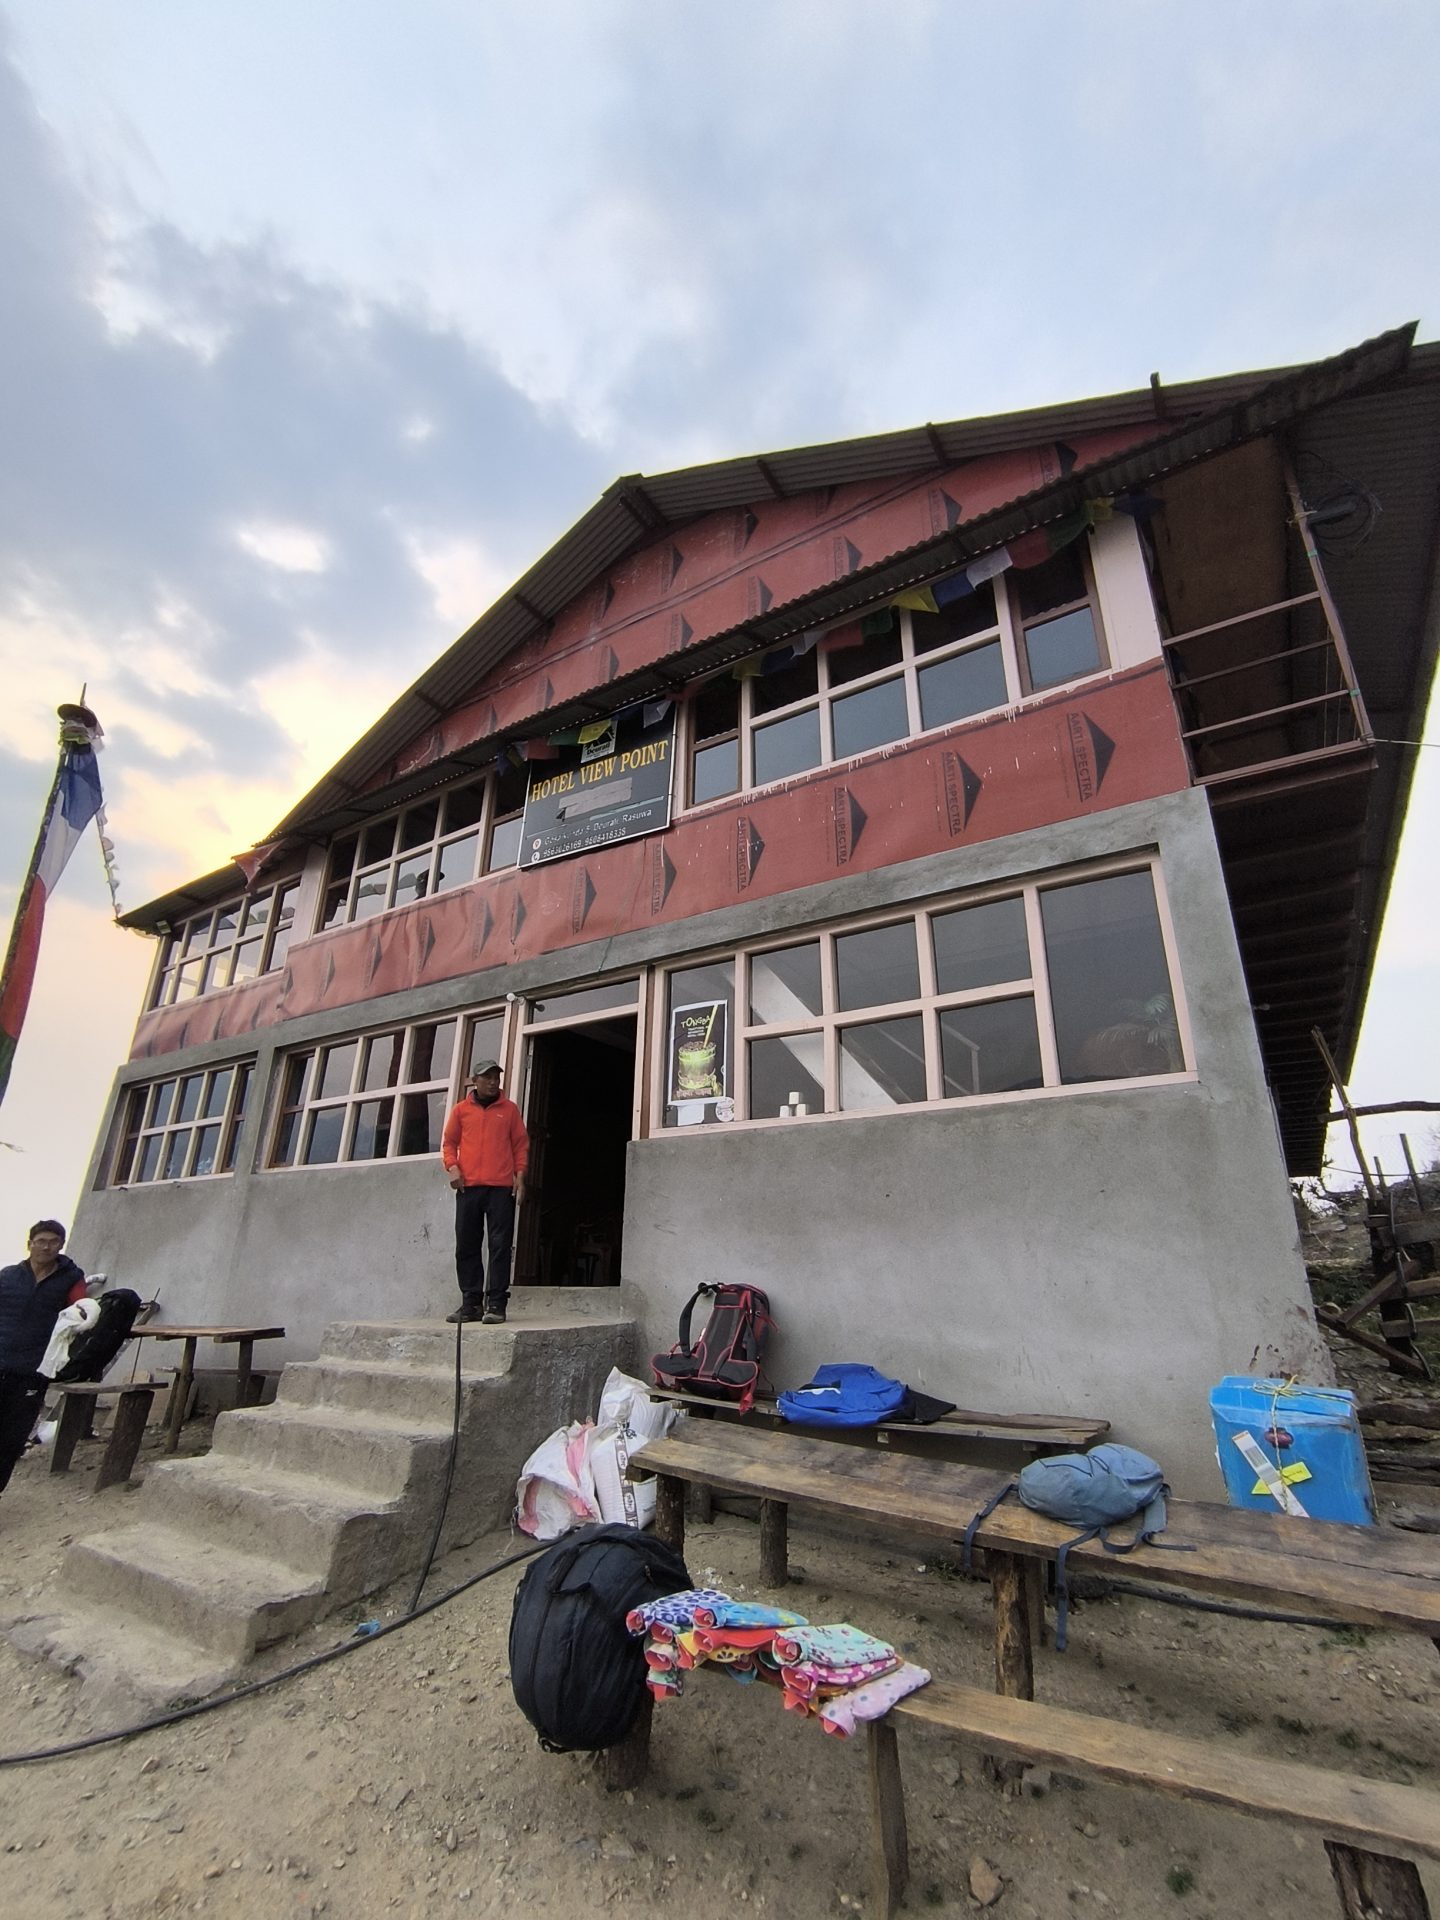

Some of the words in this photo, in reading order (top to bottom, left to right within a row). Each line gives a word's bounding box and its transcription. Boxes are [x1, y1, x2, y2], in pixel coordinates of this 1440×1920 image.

[1070, 712, 1084, 743] AARTI
[531, 771, 576, 803] HOTEL
[580, 756, 617, 786] VIEW
[620, 740, 669, 773] POINT
[1075, 746, 1093, 801] SPECTRA
[948, 783, 962, 835] SPECTRA
[681, 1015, 710, 1028] TONGBA
